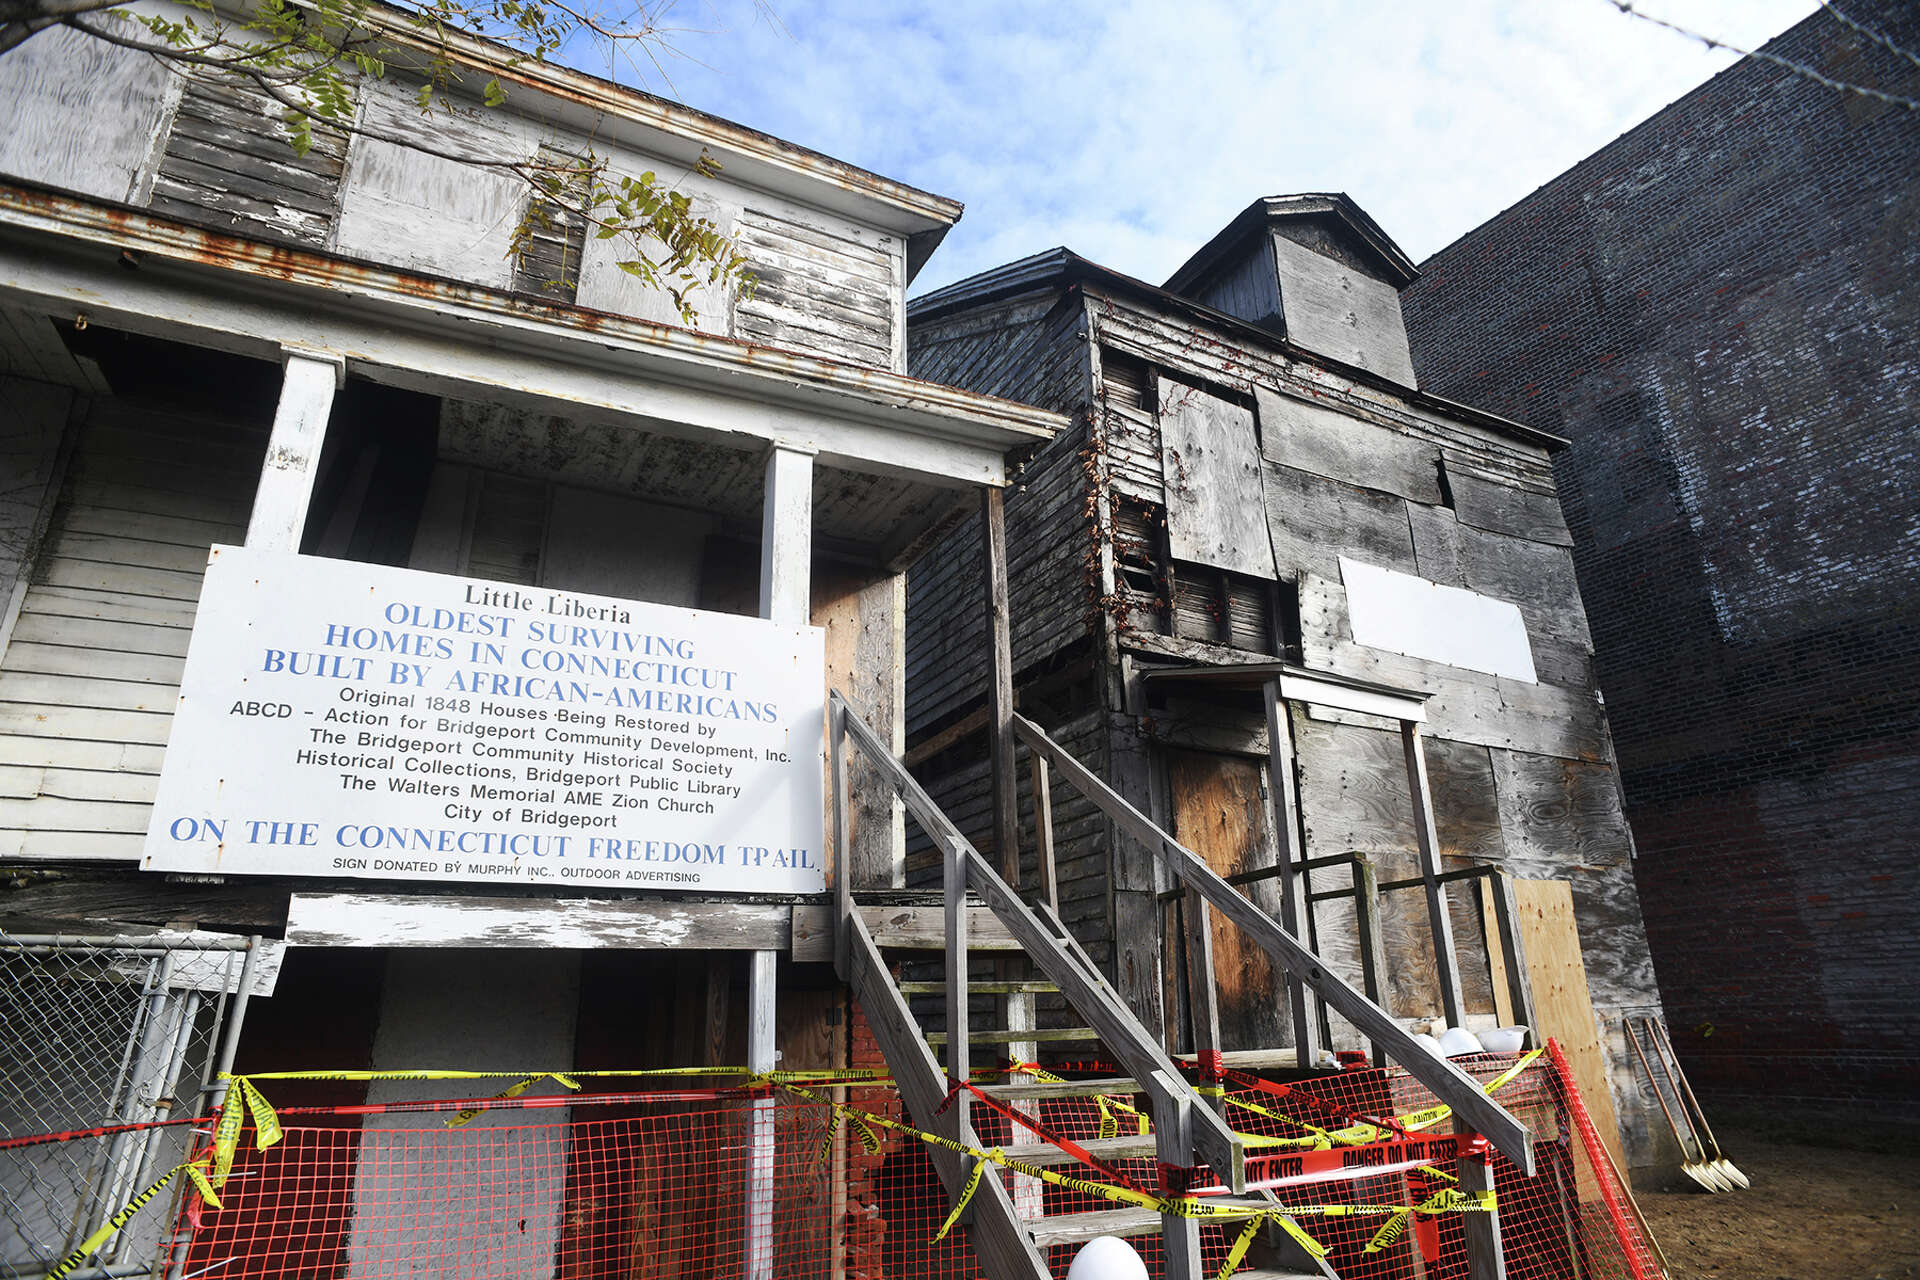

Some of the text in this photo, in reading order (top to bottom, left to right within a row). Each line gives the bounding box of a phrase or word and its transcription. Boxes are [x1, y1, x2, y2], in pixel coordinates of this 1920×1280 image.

[465, 585, 631, 624] Little Liberia
[385, 603, 693, 659] OLDEST SURVIVING
[324, 624, 736, 690] HOMES IN CONNECTICUT
[262, 650, 777, 722] BUILT BY AFRICAN-AMERICANS
[230, 701, 292, 718] ABCD
[324, 708, 388, 726] Action
[400, 715, 427, 730] for
[437, 718, 535, 740] Bridgeport
[546, 728, 642, 750] Community
[651, 738, 757, 760] Development,
[766, 749, 791, 762] Inc.
[340, 688, 716, 738] Original 1848 Houses Being Restored by
[296, 749, 740, 798] Historical Collections, Bridgeport Public Library
[310, 728, 732, 778] The Bridgeport Community Historical Society
[340, 774, 714, 814] The Walters Memorial AME Zion Church
[444, 804, 616, 828] City of Bridgeport
[170, 817, 228, 842] ON
[246, 821, 318, 846] THE
[336, 825, 571, 856] CONNECTICUT
[588, 838, 724, 864] FREEDOM
[332, 858, 367, 869] SIGN
[374, 860, 438, 872] DONATED
[444, 863, 462, 873] BY
[468, 864, 521, 876] MURPHY
[561, 867, 620, 879] OUTDOOR
[626, 871, 700, 882] ADVERTISING
[1269, 1157, 1302, 1179] ENTER
[1343, 1147, 1384, 1167] DANGER
[1388, 1145, 1402, 1163] DO
[1406, 1142, 1424, 1161] NOT
[110, 1167, 175, 1230] CAUTION
